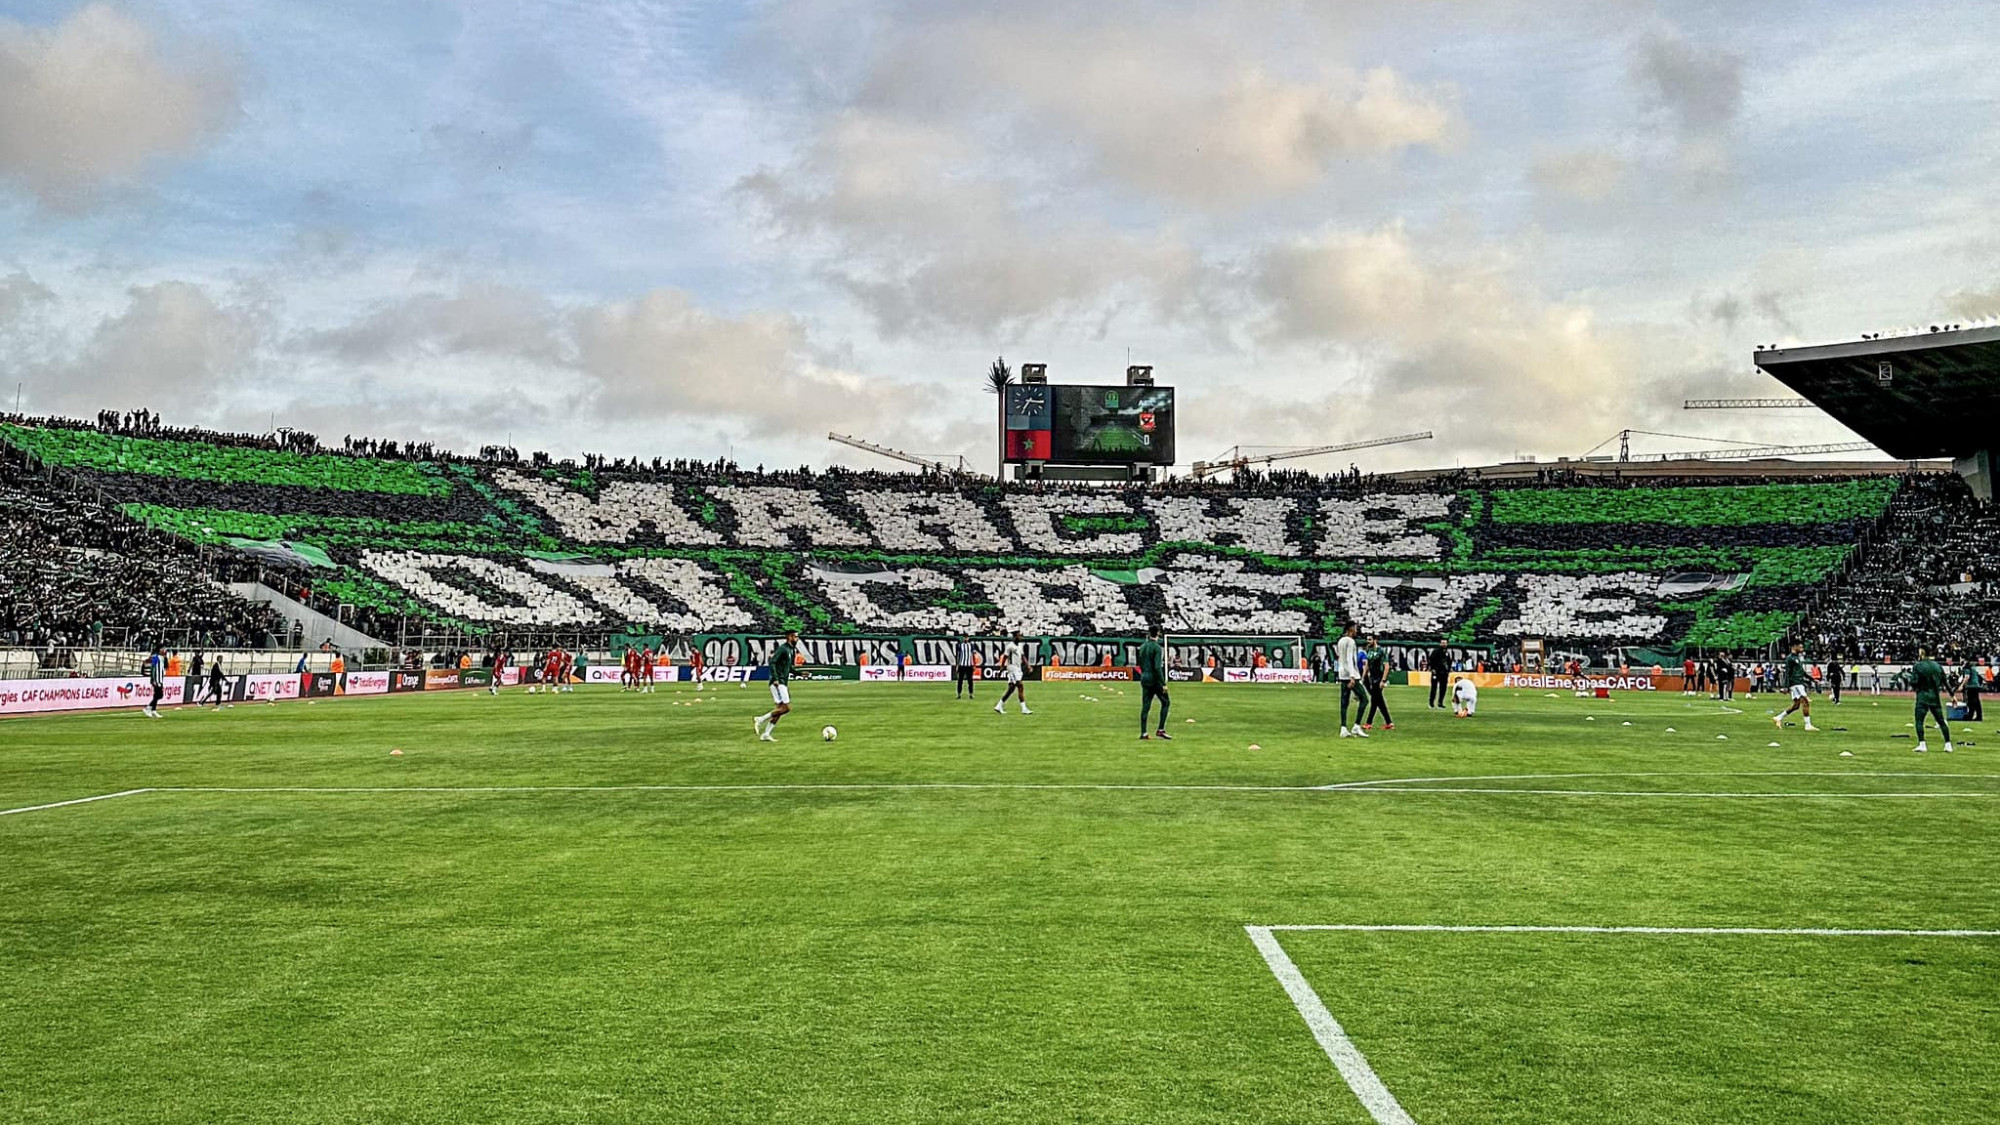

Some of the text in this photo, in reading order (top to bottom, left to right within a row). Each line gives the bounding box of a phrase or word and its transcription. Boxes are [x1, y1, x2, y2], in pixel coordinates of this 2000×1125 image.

[705, 638, 740, 666] 90
[748, 638, 899, 667] MNUTES
[592, 670, 625, 680] QNE
[886, 669, 947, 679] TotlEnergies
[22, 690, 39, 702] CAF
[40, 688, 80, 701] CHAMPIONS
[81, 687, 109, 699] LEAGUE
[135, 683, 182, 700] Totalrgies
